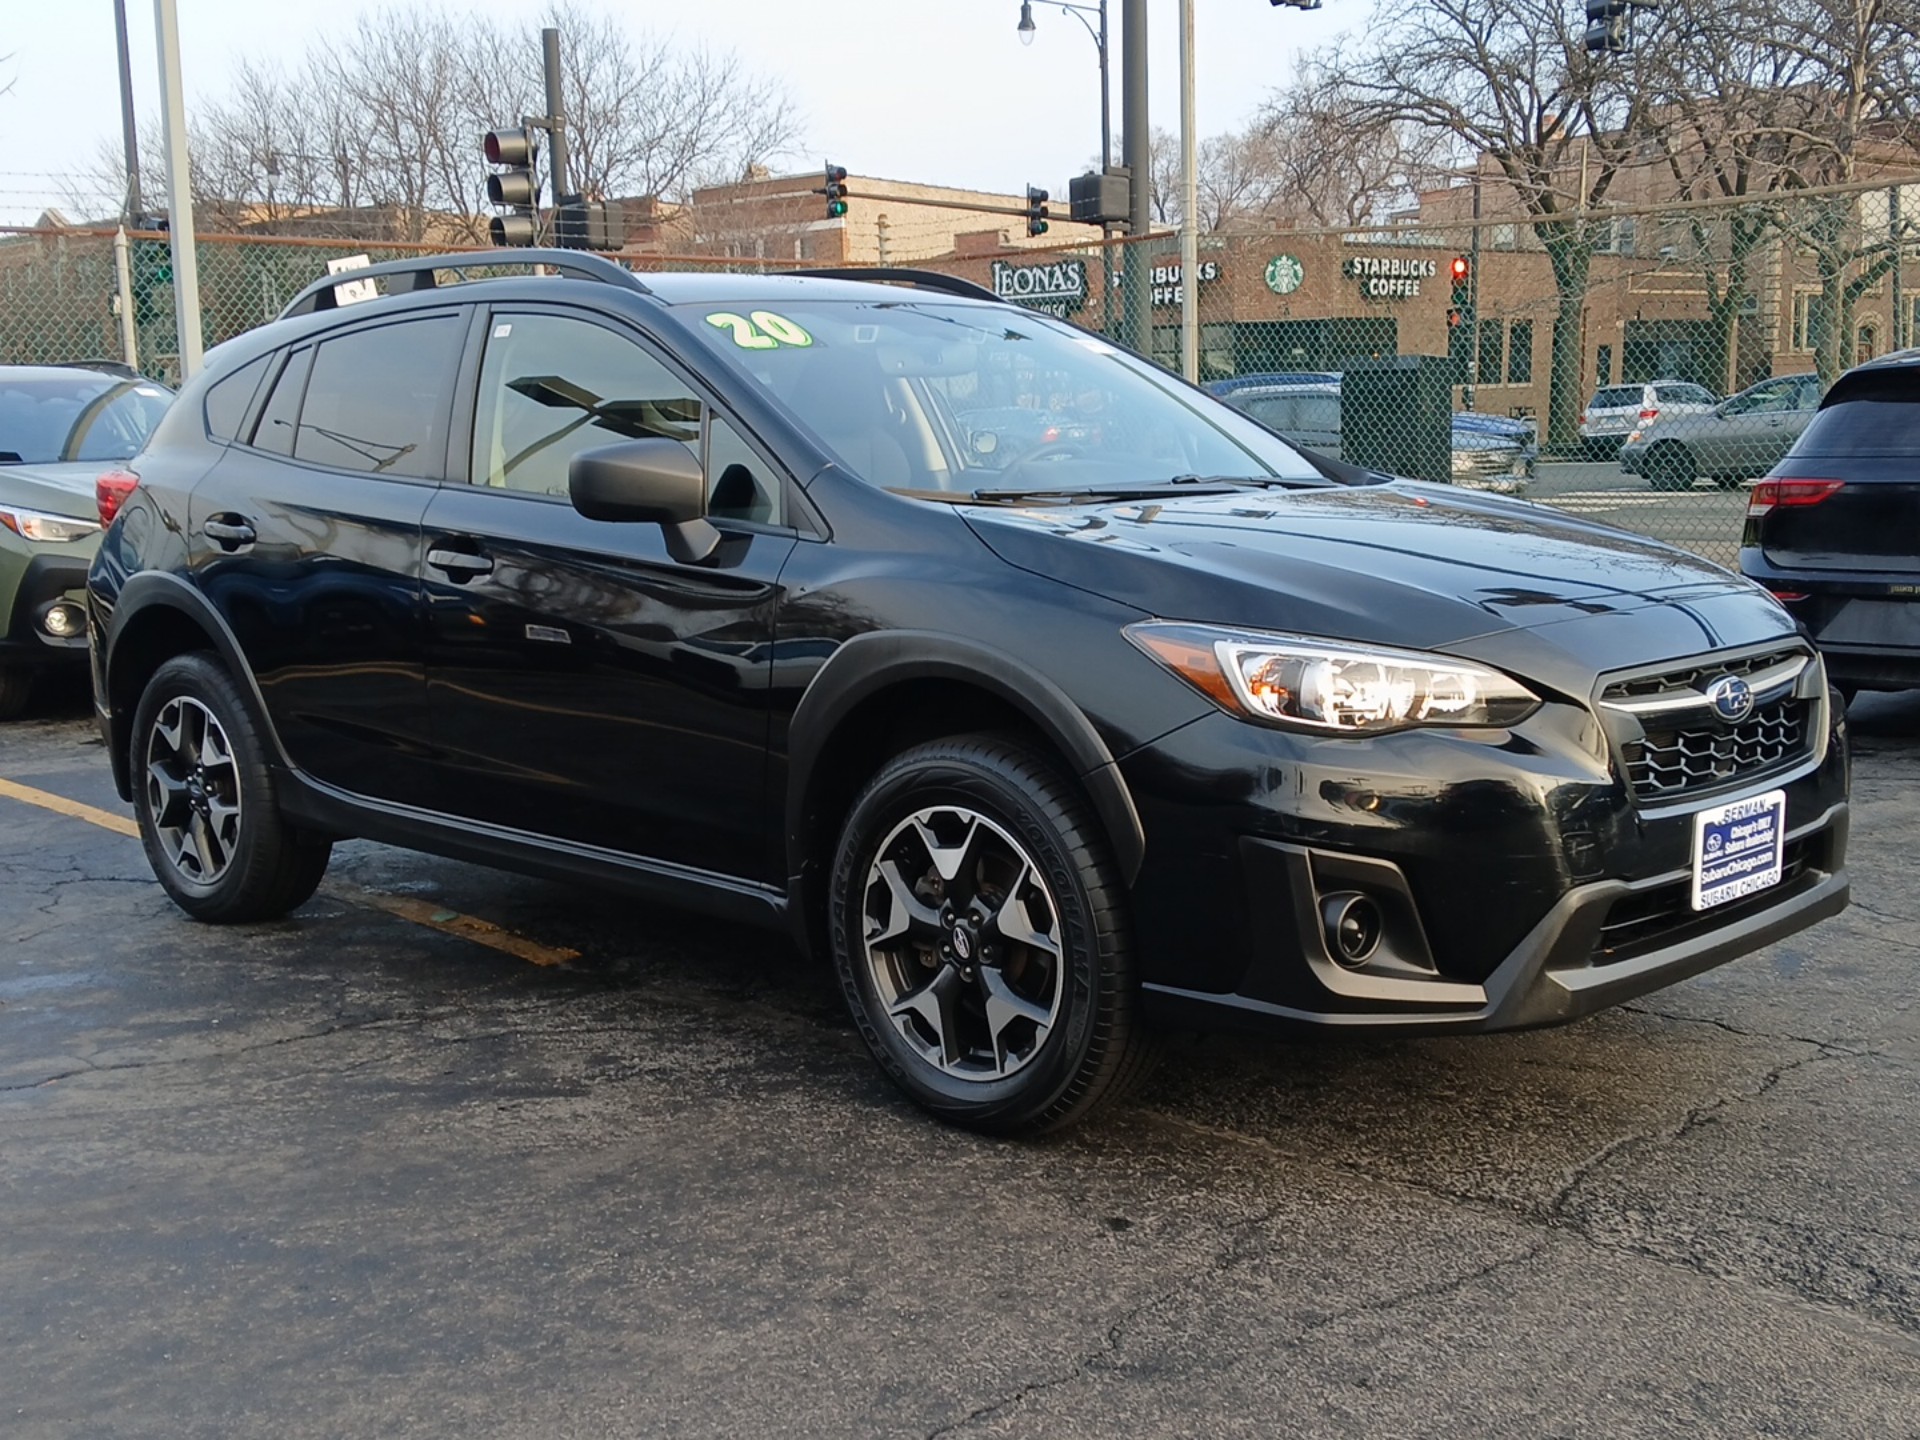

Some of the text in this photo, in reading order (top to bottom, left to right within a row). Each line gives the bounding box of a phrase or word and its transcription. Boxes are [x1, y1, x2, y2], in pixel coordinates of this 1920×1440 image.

[993, 262, 1081, 296] LEONA'S
[1353, 256, 1436, 277] STARBUCKS
[1369, 278, 1420, 296] COFFEE
[704, 309, 813, 350] 20
[1700, 869, 1779, 909] SUBARU CHICAGO
